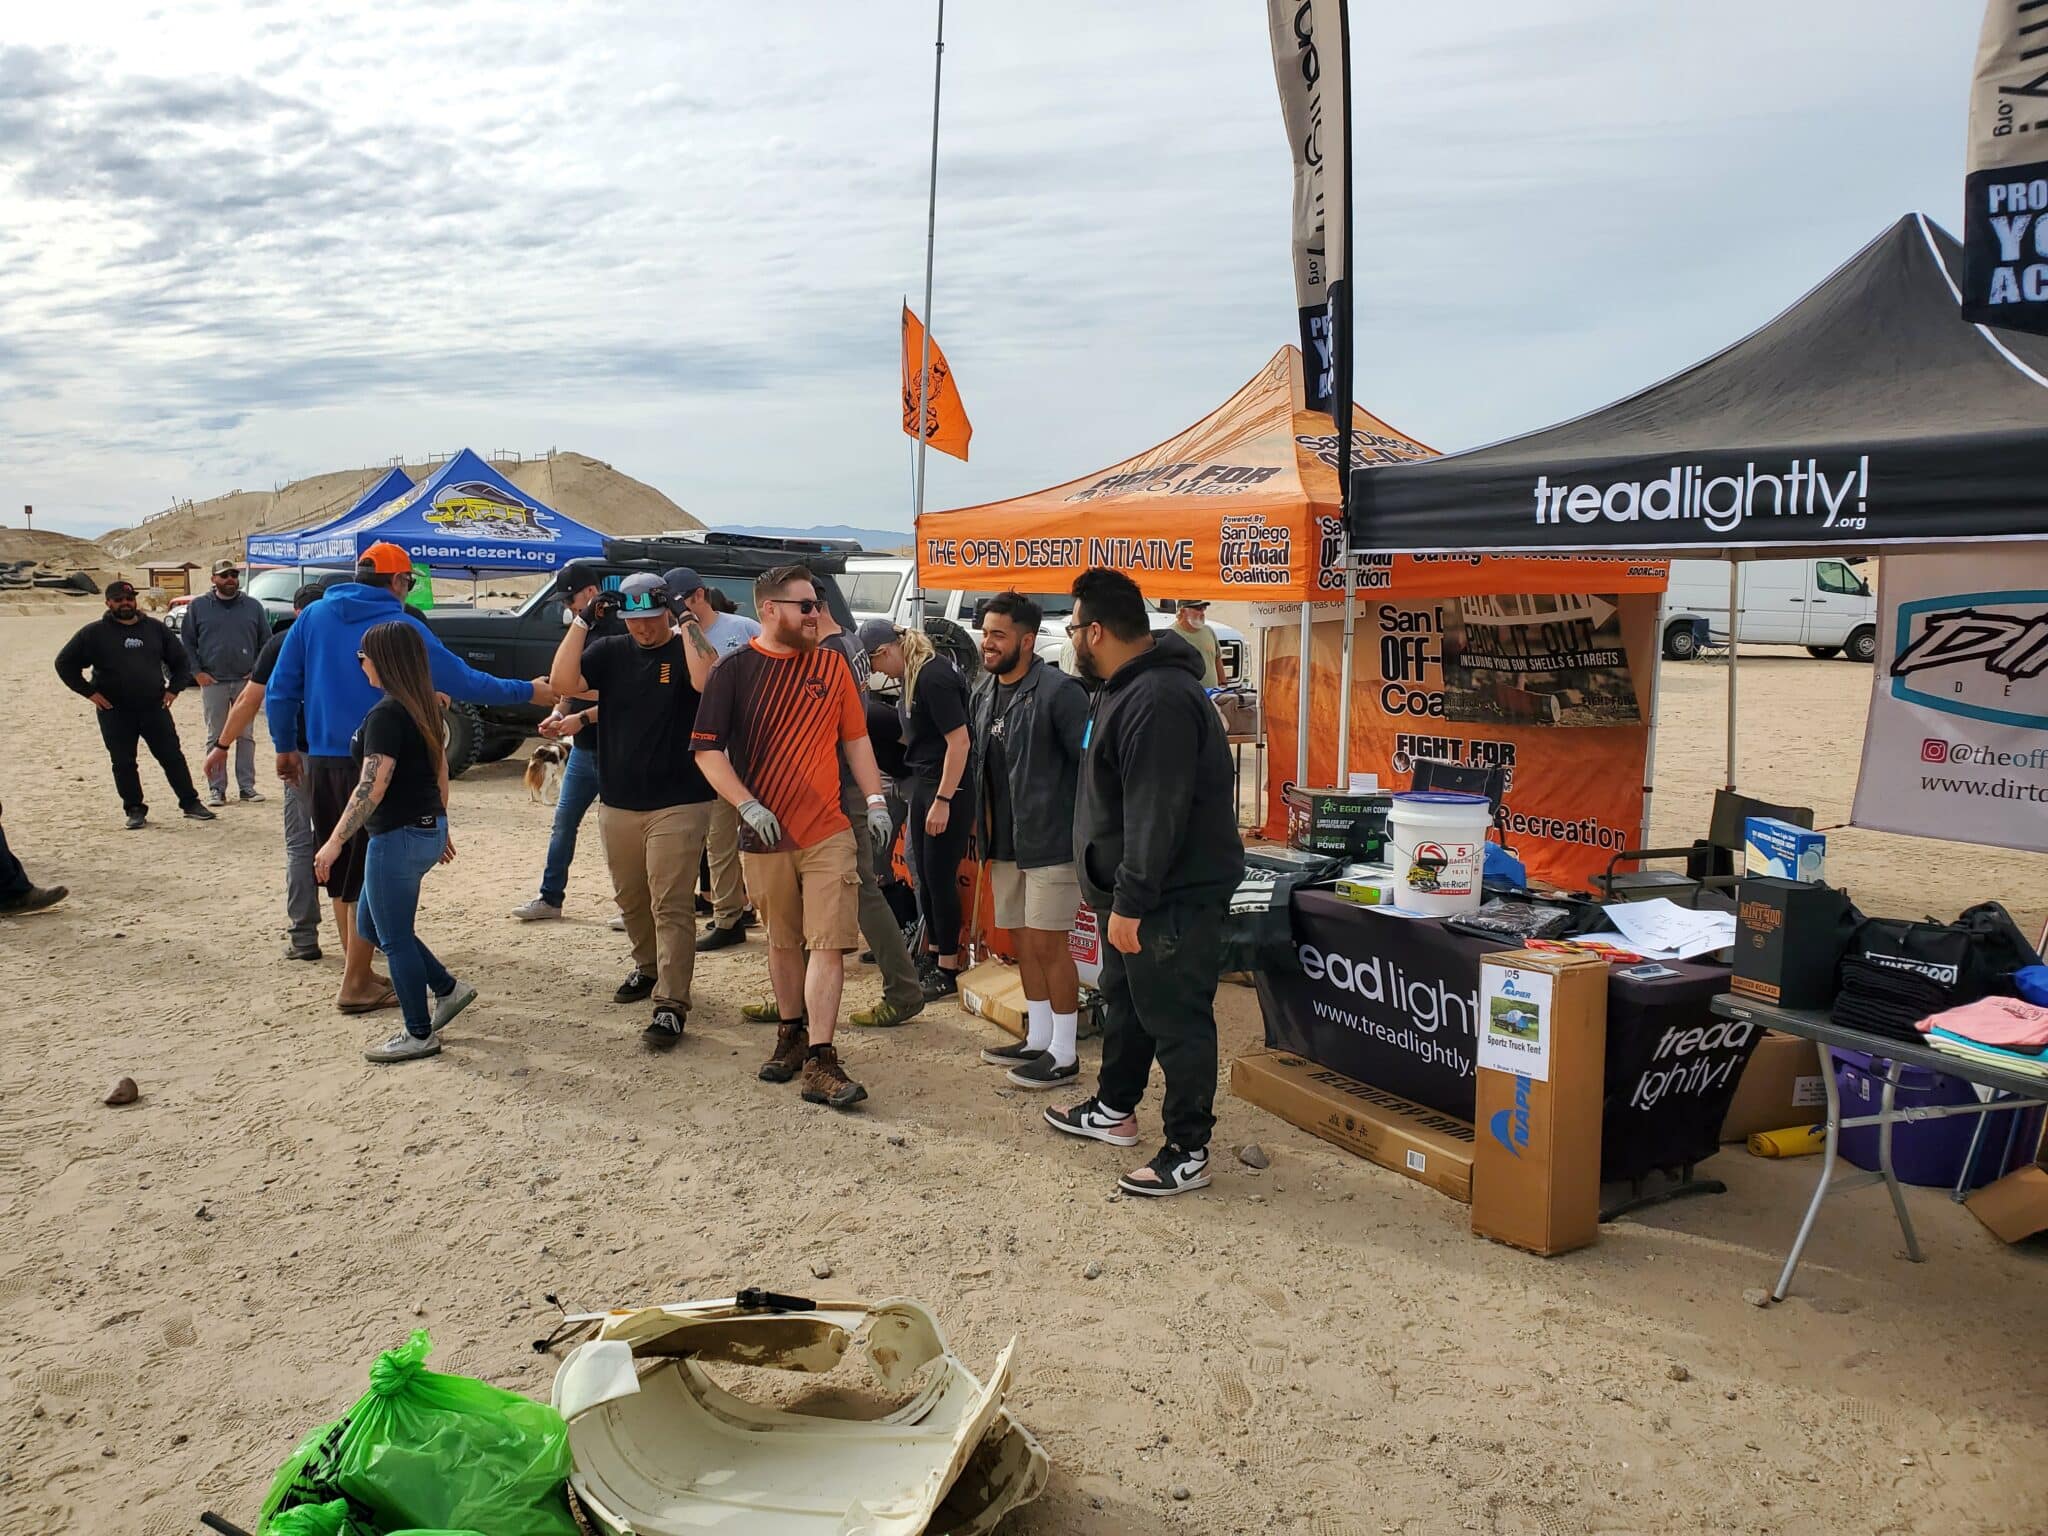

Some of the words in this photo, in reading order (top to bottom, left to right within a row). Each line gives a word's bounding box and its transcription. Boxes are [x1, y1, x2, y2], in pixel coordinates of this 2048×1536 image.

[1993, 99, 2014, 137] .org
[1308, 257, 1320, 285] .org
[1191, 464, 1282, 484] FOR
[1534, 456, 1870, 532] treadlightly!
[1223, 515, 1252, 523] Powered
[1835, 515, 1867, 531] .org
[1221, 527, 1248, 540] San
[1249, 525, 1289, 543] Diego
[410, 545, 556, 564] clean-dezert.org
[927, 540, 957, 565] THE
[960, 540, 1010, 566] OPEN
[1014, 538, 1083, 566] DESERT
[1089, 538, 1194, 570] INITIATIVE
[1221, 568, 1290, 584] Coalition
[1319, 569, 1391, 589] Coaition
[1258, 607, 1276, 615] Your
[1379, 604, 1432, 633] San
[1529, 655, 1565, 671] SHELLS
[1567, 655, 1575, 667] &
[1576, 651, 1619, 667] TARGETS
[1396, 733, 1463, 761] FIGHT
[1470, 740, 1516, 767] FOR
[1499, 804, 1627, 851] Recreation
[1317, 842, 1346, 850] POWER
[1457, 847, 1466, 857] 5
[1487, 1035, 1508, 1048] Sportz
[1508, 1039, 1526, 1052] Truck
[1527, 1043, 1542, 1055] Tent
[1307, 1071, 1427, 1115] RECOVERY
